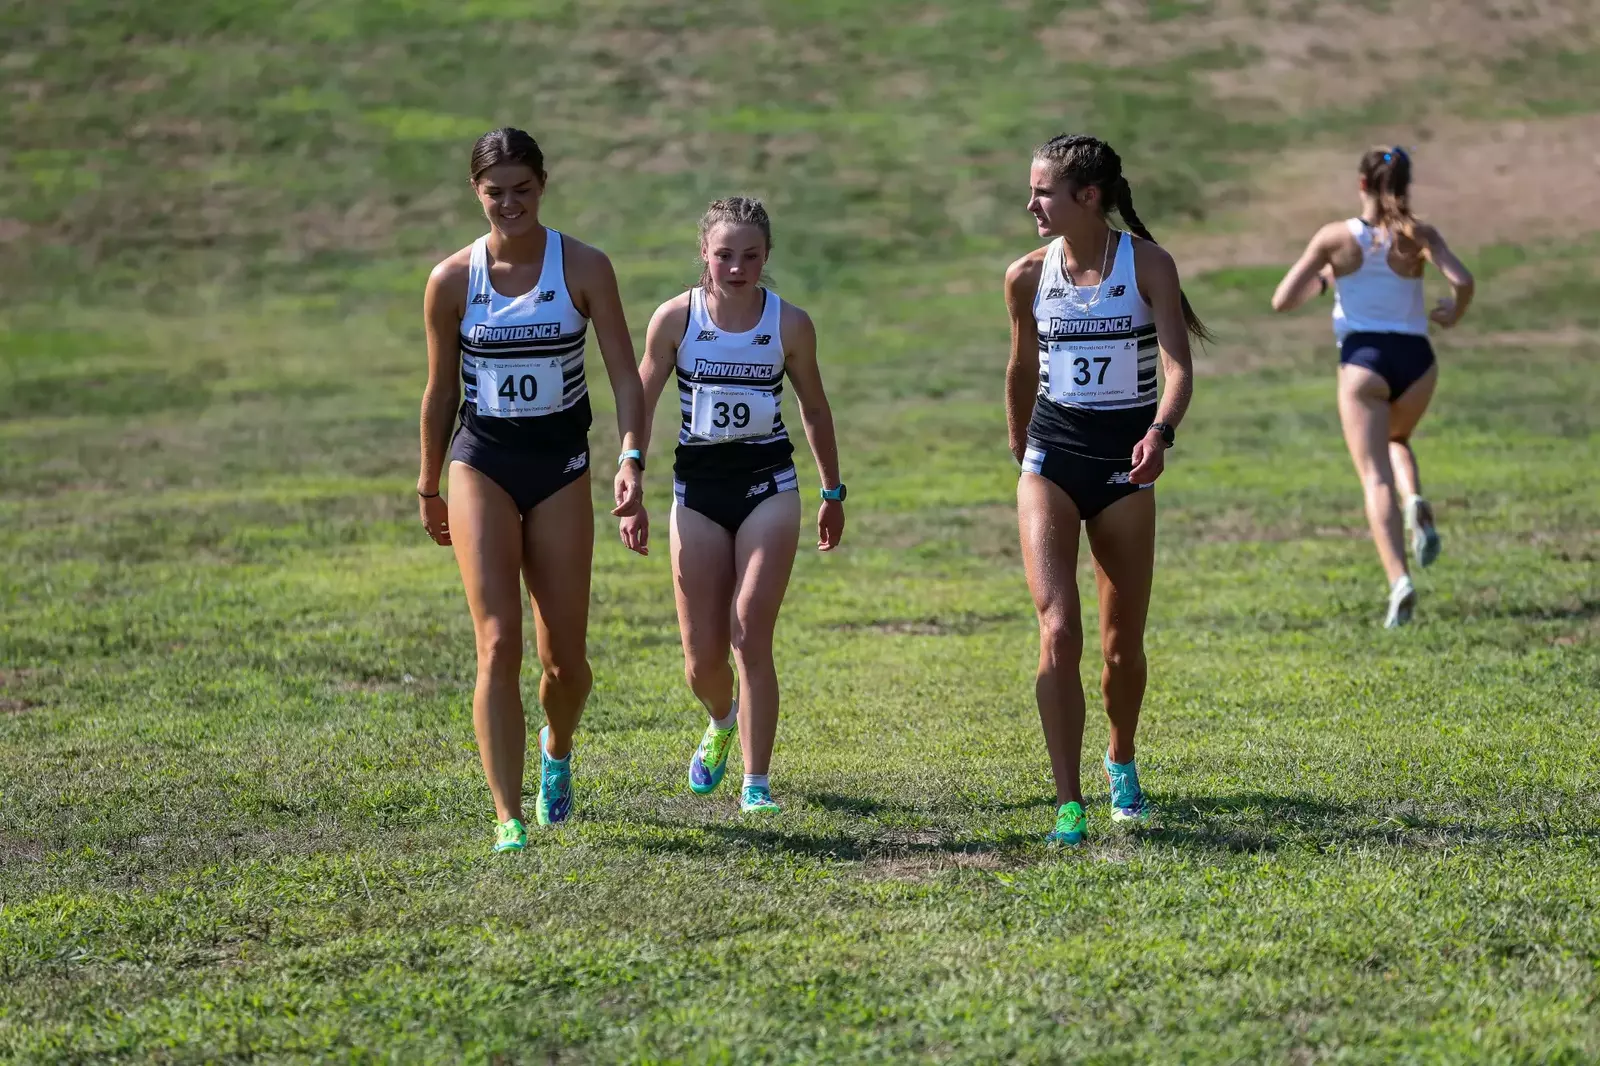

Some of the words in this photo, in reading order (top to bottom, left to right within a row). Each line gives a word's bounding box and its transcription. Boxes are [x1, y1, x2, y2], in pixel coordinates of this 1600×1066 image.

[474, 323, 559, 345] PROVIDENCE
[1048, 316, 1131, 339] PROVIDENCE
[692, 359, 773, 380] PROVIDENCE
[1073, 357, 1112, 386] 37
[498, 374, 538, 402] 40
[712, 402, 751, 429] 39
